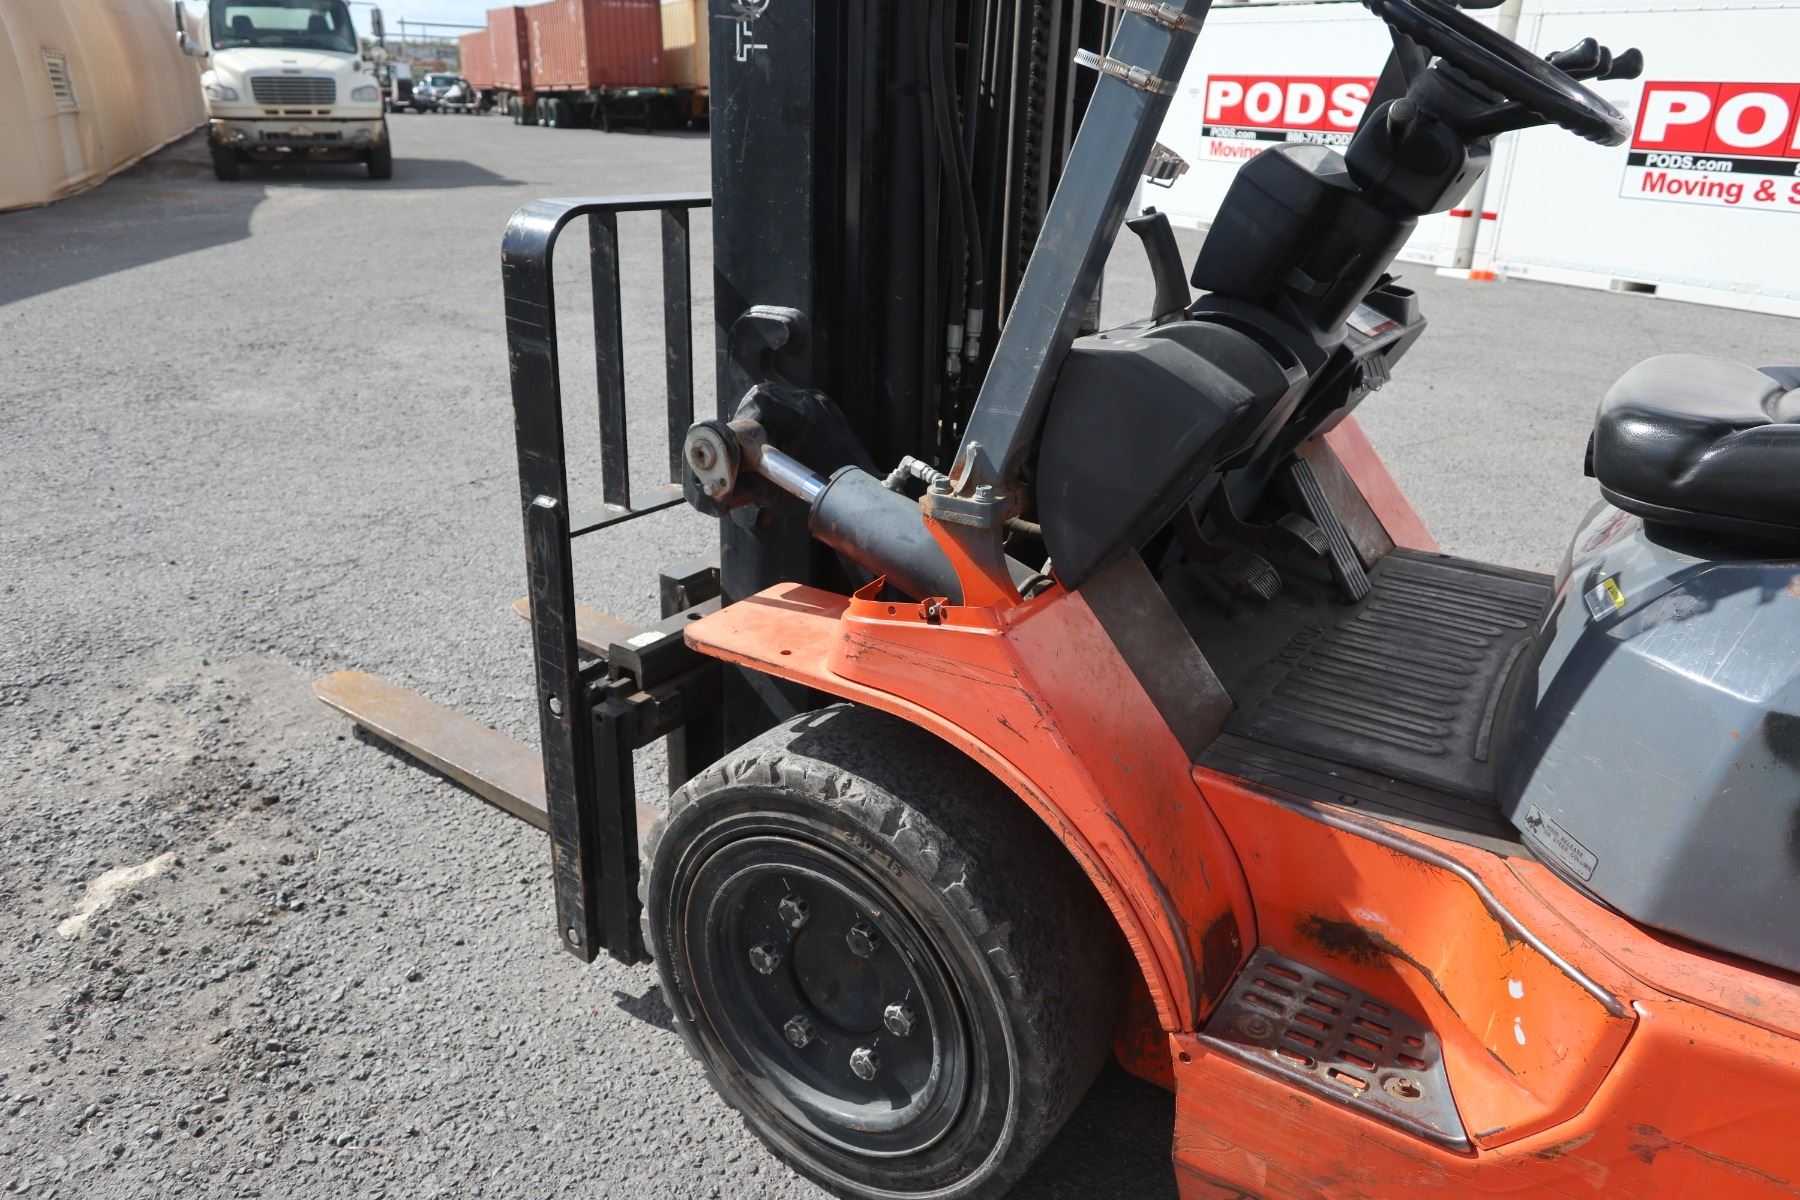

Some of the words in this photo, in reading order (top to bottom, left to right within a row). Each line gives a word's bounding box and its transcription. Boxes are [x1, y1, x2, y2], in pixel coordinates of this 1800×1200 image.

[1205, 81, 1370, 127] PODS
[1639, 89, 1800, 150] PO
[1209, 127, 1257, 140] PODS.com
[1645, 154, 1733, 172] PODS.com
[1641, 171, 1744, 205] Moving
[1753, 179, 1776, 202] &
